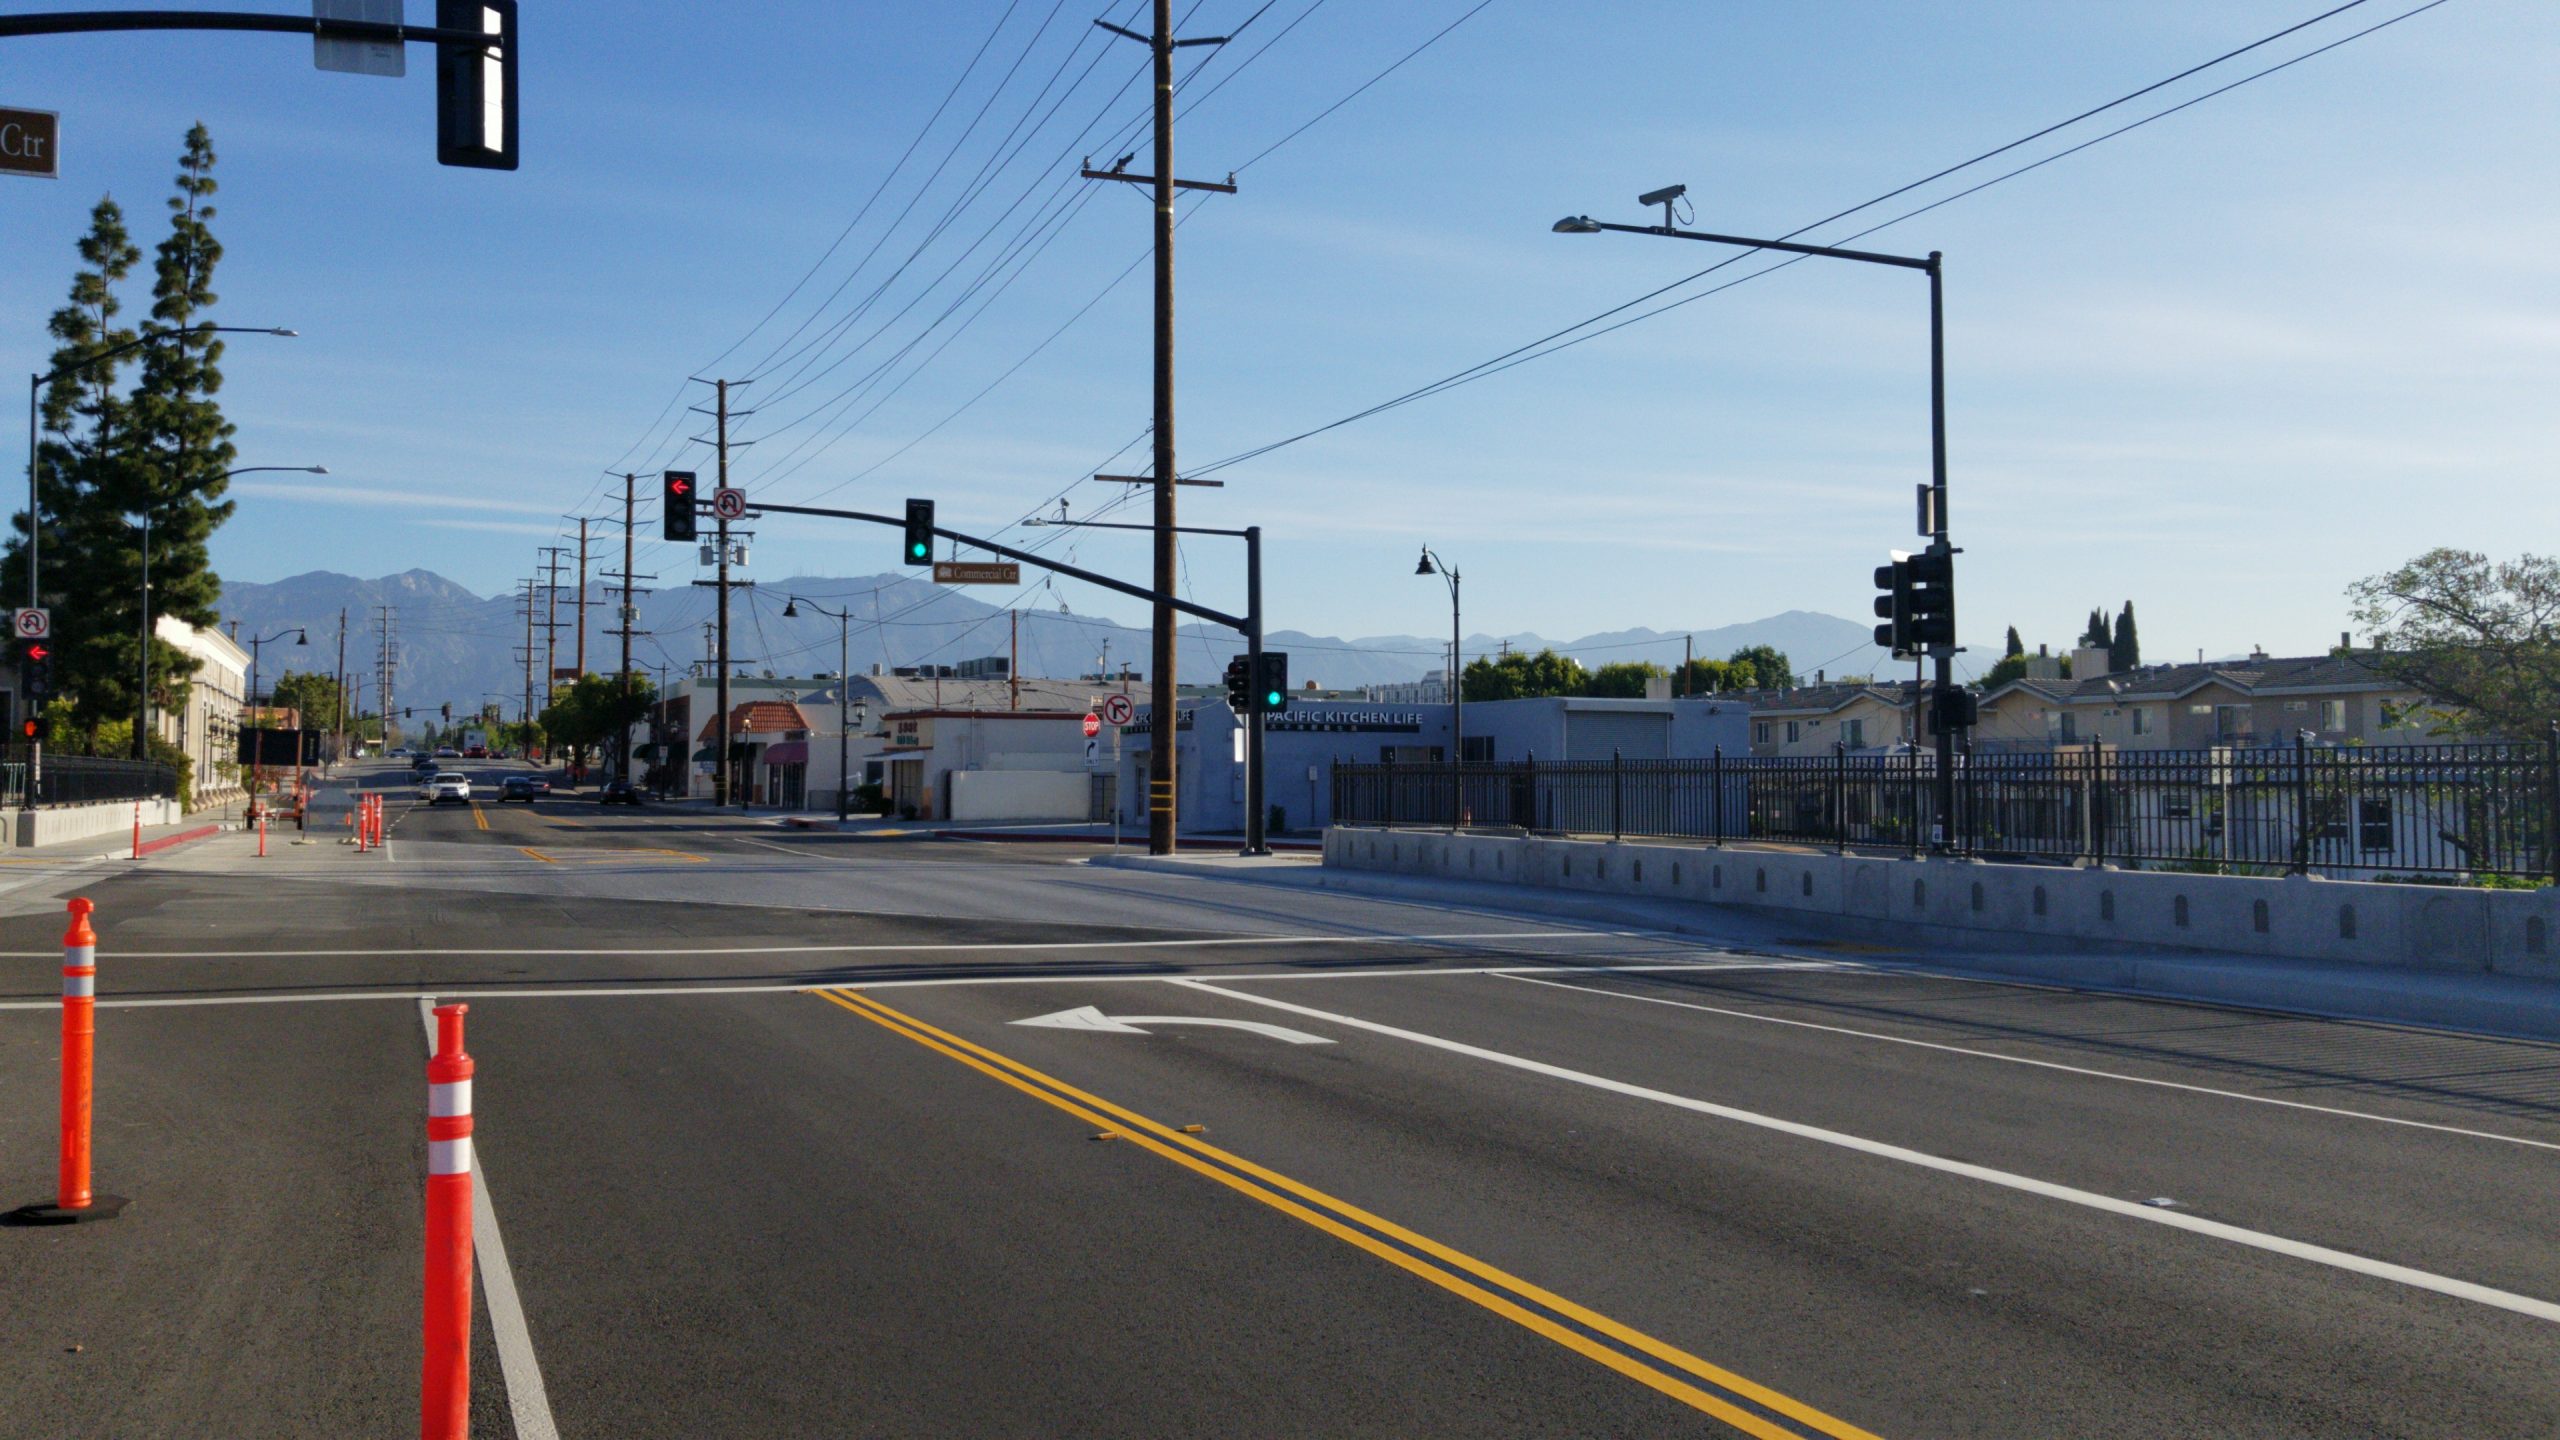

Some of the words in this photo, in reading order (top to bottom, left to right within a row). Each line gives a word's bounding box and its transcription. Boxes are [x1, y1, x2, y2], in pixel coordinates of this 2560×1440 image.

[1, 123, 44, 157] Ctr
[954, 567, 1001, 580] Commercial
[1267, 711, 1320, 722] PACIFIC
[1326, 711, 1389, 724] KITCHEN
[1394, 713, 1423, 724] LIFE
[1084, 721, 1099, 731] STOP
